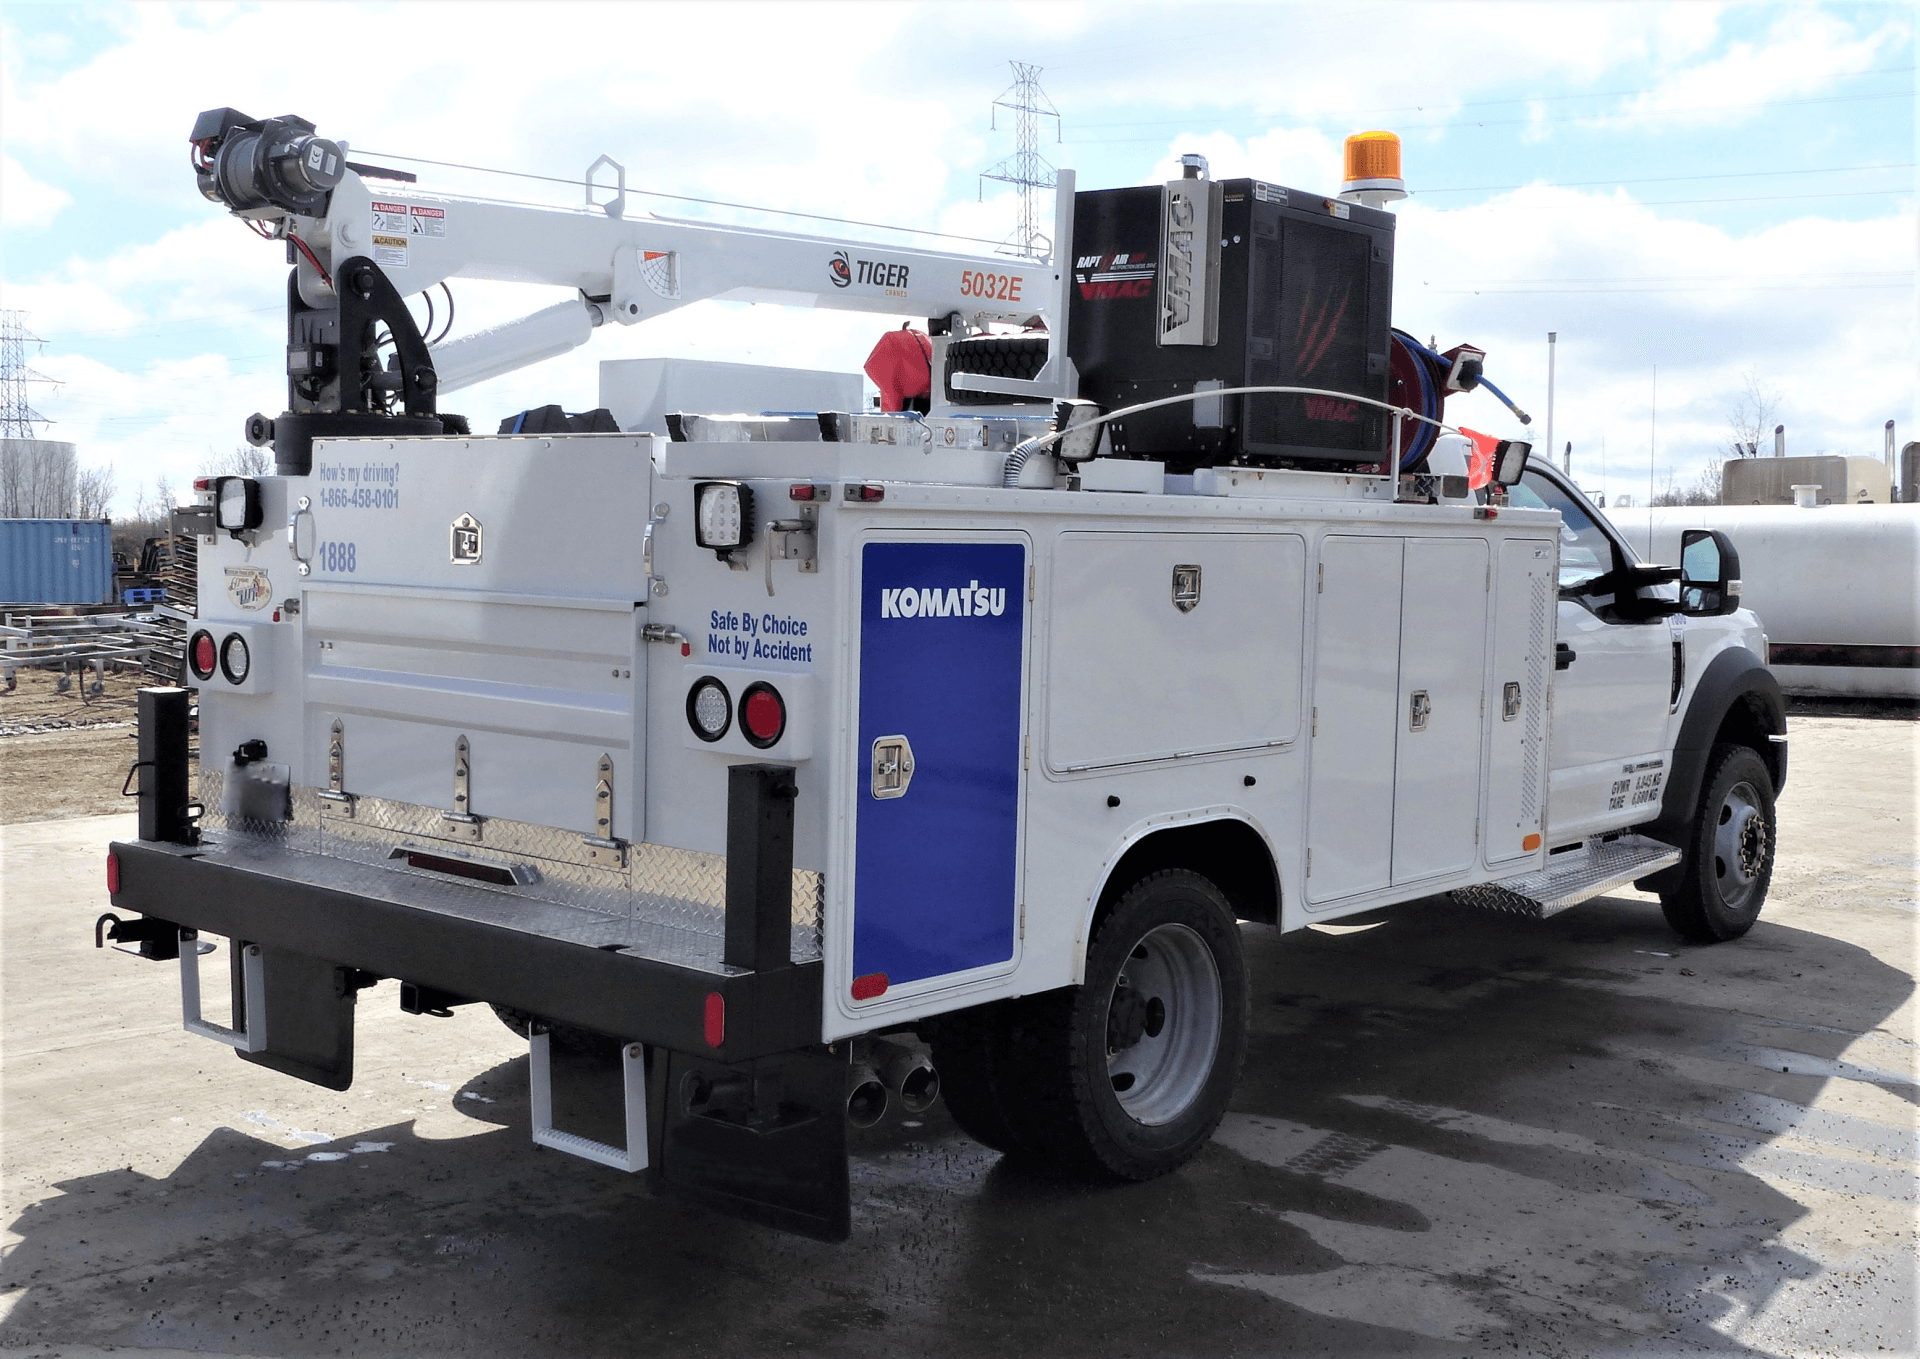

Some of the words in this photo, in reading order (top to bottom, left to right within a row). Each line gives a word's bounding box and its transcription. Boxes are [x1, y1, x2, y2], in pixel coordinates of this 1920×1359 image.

[380, 204, 406, 213] DANGER
[418, 208, 444, 217] DANGER
[380, 237, 407, 246] CAUTION
[856, 259, 910, 289] TIGER
[1163, 193, 1195, 335] VMAC
[960, 270, 1023, 302] 5032E
[1079, 279, 1153, 301] VMAC
[1304, 393, 1359, 422] VMAC
[320, 462, 346, 482] How's
[348, 467, 361, 487] my
[363, 462, 400, 488] driving?
[320, 487, 399, 509] 1-866-458-0101
[319, 541, 357, 573] 1888
[881, 579, 1006, 619] KOMATSU
[710, 610, 739, 631] Safe
[742, 612, 758, 638] By
[762, 613, 808, 636] Choice
[708, 633, 731, 654] Not
[734, 635, 750, 660] by
[753, 638, 812, 662] Accident
[1611, 779, 1631, 796] GVWR
[1652, 772, 1662, 786] KG
[1608, 795, 1626, 811] TARE
[1648, 788, 1658, 801] KG
